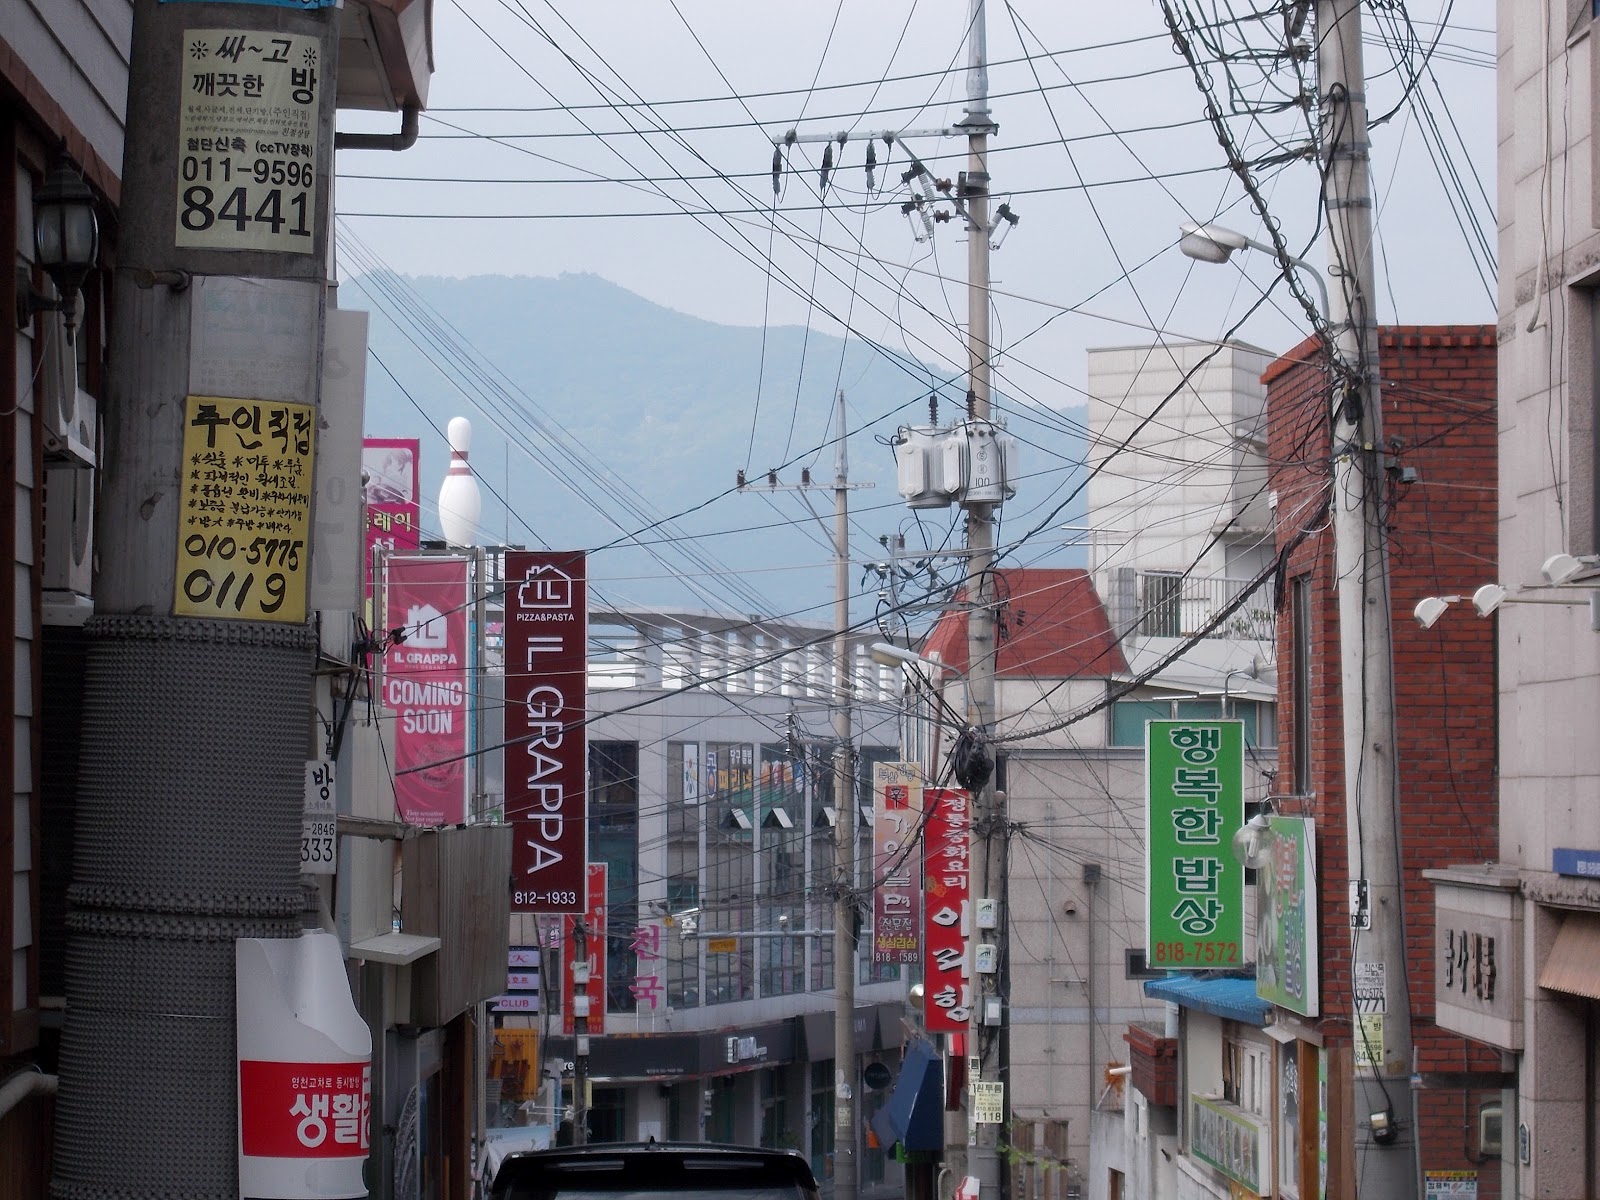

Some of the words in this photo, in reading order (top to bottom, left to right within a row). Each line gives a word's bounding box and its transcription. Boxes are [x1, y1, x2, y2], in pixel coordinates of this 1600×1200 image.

[192, 72, 264, 98] 깨끗한
[291, 67, 317, 105] 방
[187, 136, 247, 153] 첨단신축
[182, 156, 313, 188] 011-9596
[181, 186, 311, 236] 8441
[192, 404, 311, 456] 주인직접
[199, 498, 226, 514] 보증금
[185, 534, 303, 571] 010-5775
[184, 569, 286, 613] 0119
[516, 613, 575, 622] PIZZA&PASTA
[406, 653, 457, 664] GRAPPA
[527, 637, 563, 671] IL
[389, 680, 463, 706] COMING
[403, 708, 452, 734] SOON
[312, 763, 334, 800] 방
[526, 685, 564, 875] GRAPPA
[878, 767, 898, 783] 부산
[1168, 726, 1224, 845] 행복한
[942, 797, 969, 890] 정통중화요리
[514, 892, 577, 905] 812-1933
[1170, 857, 1225, 937] 밥상
[882, 917, 912, 931] 전문점
[1155, 941, 1238, 963] 818-7572
[976, 1112, 1001, 1121] 1118
